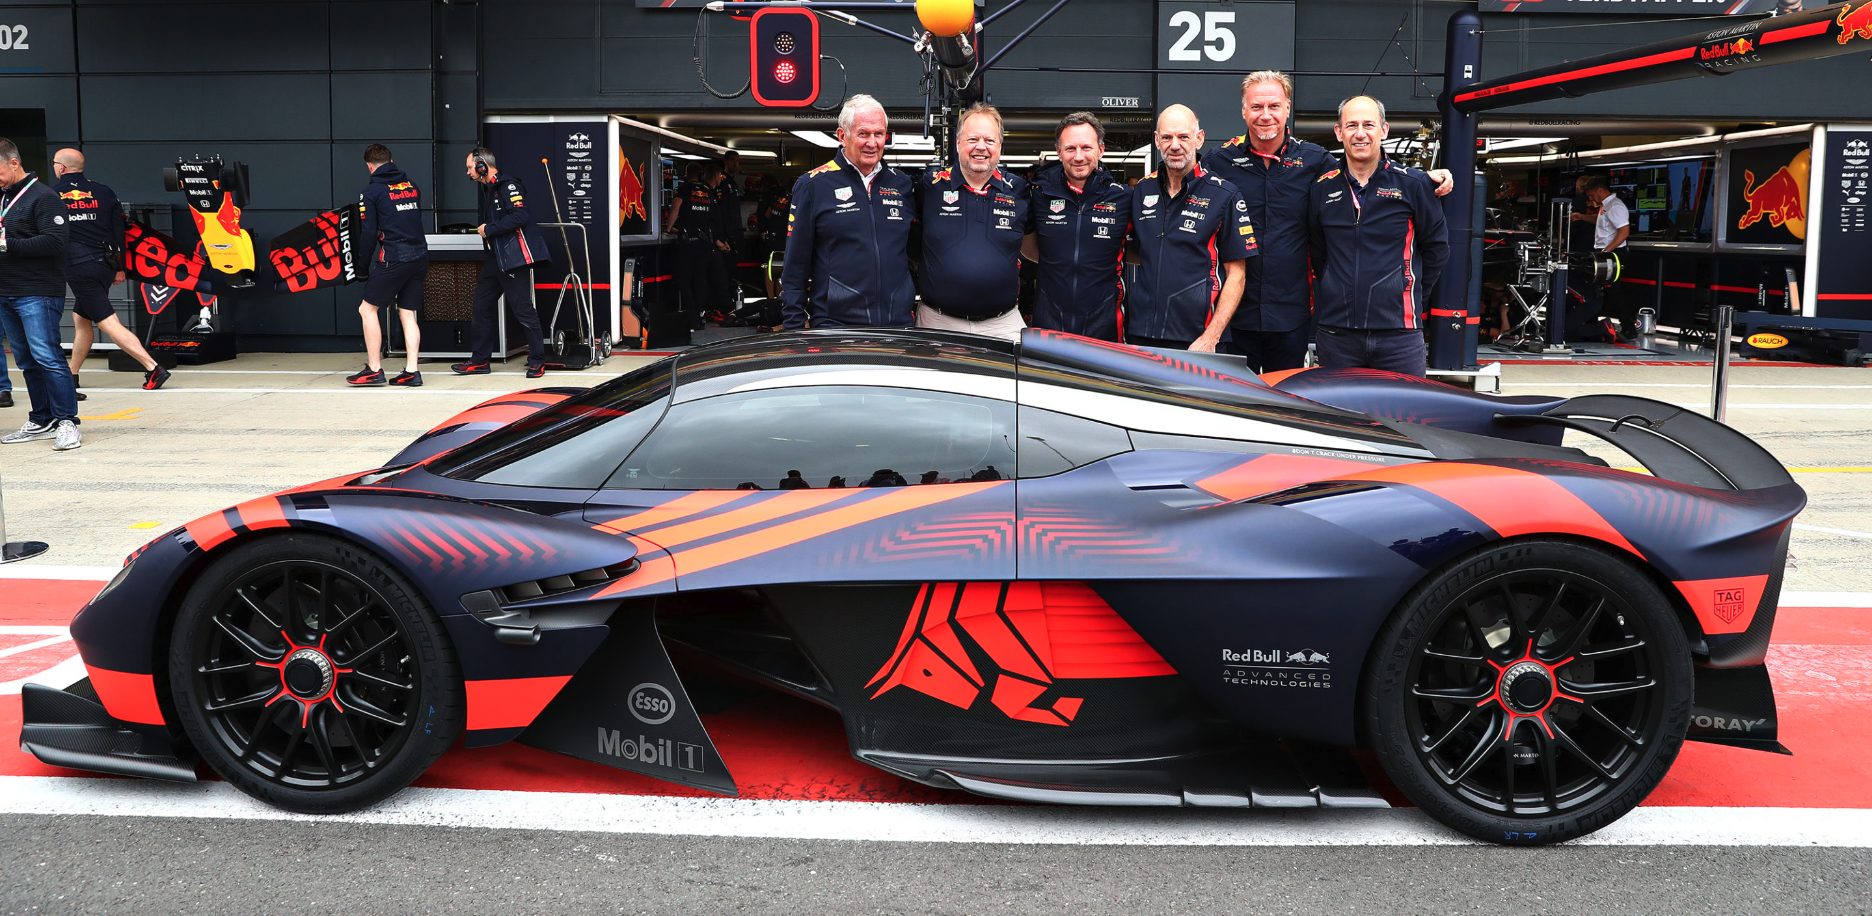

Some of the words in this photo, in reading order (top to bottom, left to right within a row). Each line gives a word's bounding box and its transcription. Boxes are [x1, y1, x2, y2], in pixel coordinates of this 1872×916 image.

[0, 24, 29, 50] 02
[1169, 10, 1236, 62] 25
[1700, 45, 1715, 60] Red
[1715, 42, 1729, 57] Bull
[1101, 98, 1139, 106] OLIVER
[566, 141, 579, 149] Red
[579, 141, 592, 149] Bull
[1843, 148, 1857, 156] Red
[1856, 148, 1870, 156] Bull
[389, 191, 405, 200] Red
[404, 189, 418, 199] Bull
[79, 199, 98, 209] Bull
[396, 202, 413, 211] Mobil
[883, 198, 898, 206] Mobil
[993, 208, 1010, 216] Mobil
[1181, 209, 1198, 219] Mobil
[1091, 216, 1109, 225] Mobil
[341, 230, 356, 281] Mobil
[1211, 276, 1219, 290] Red
[1757, 337, 1784, 345] RAUCH
[1717, 591, 1742, 602] TAG
[1716, 604, 1742, 621] HEUER
[1222, 649, 1251, 662] Red
[1253, 650, 1280, 663] Bull
[1223, 669, 1331, 680] ADVANCED
[1223, 678, 1331, 689] TECHNOLOGIES
[635, 691, 669, 713] Esso
[1691, 715, 1767, 732] ORAY
[598, 726, 673, 768] Mobil
